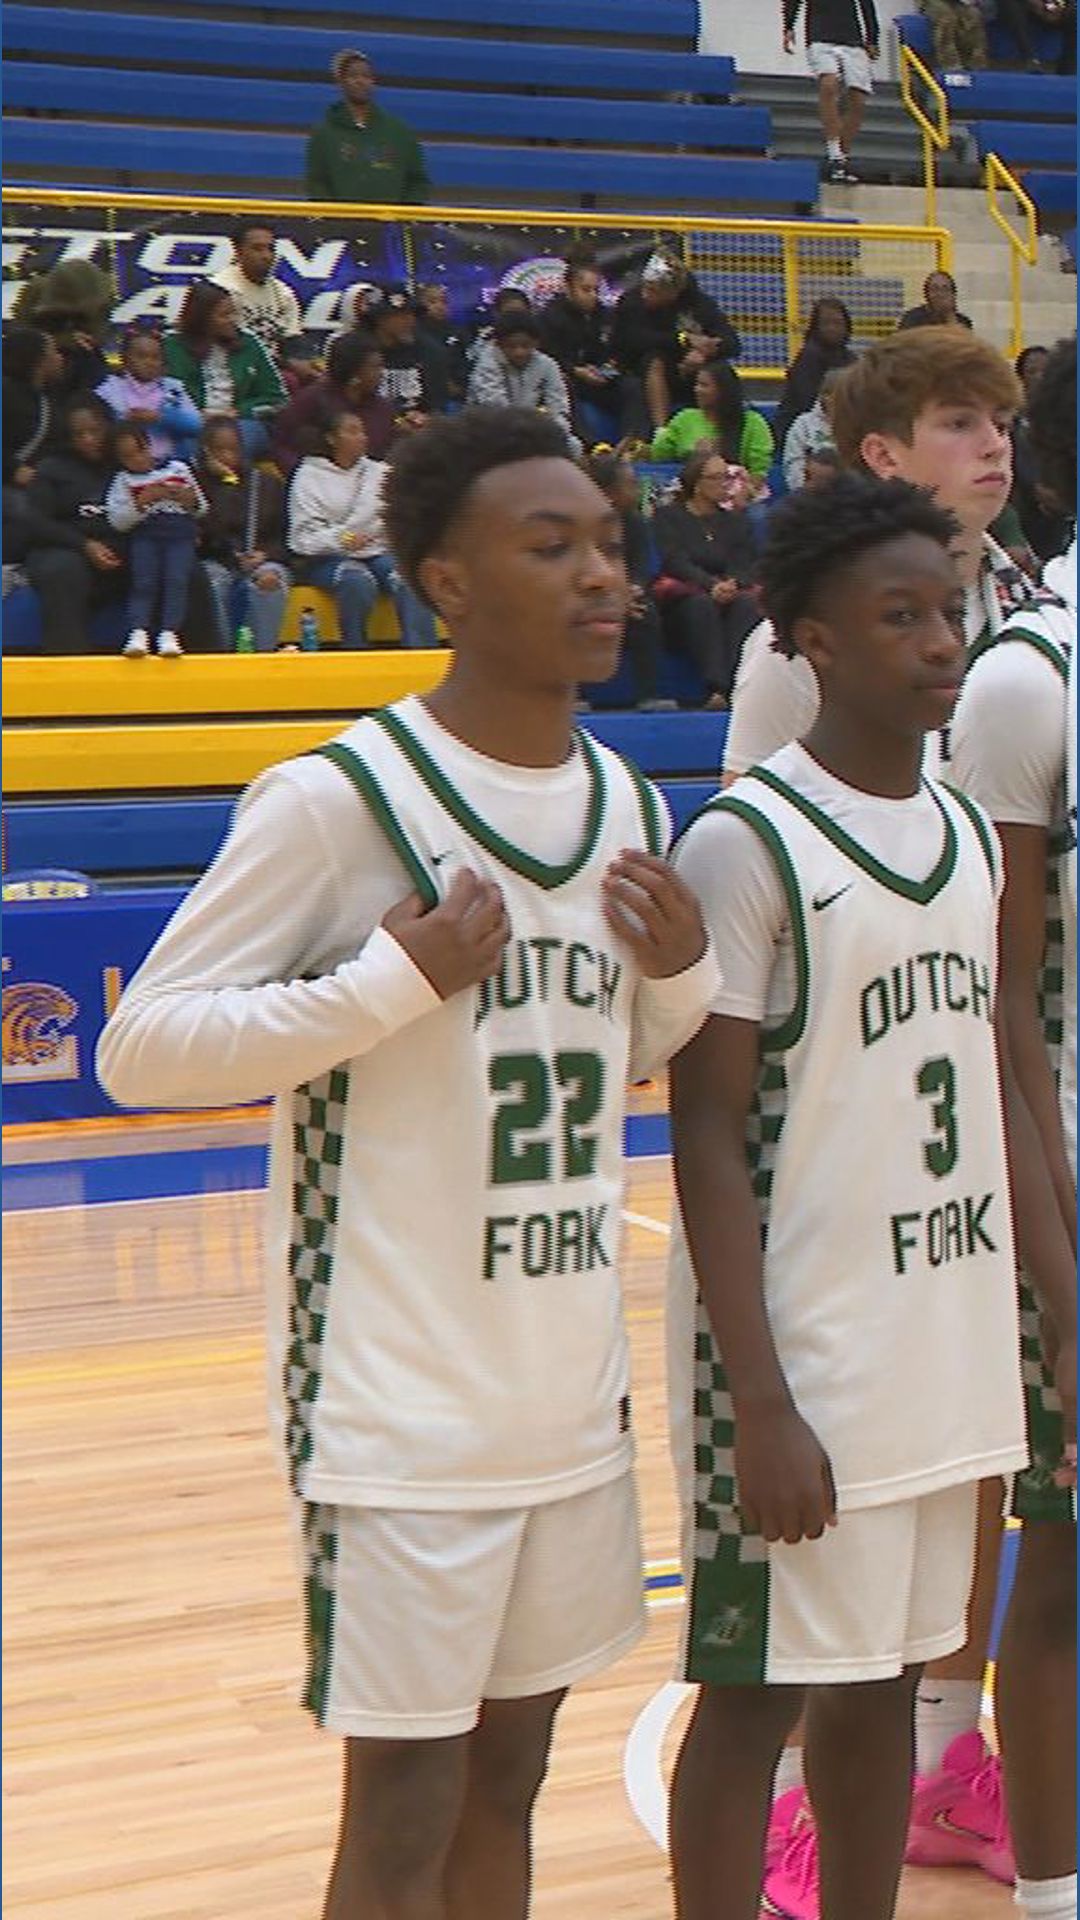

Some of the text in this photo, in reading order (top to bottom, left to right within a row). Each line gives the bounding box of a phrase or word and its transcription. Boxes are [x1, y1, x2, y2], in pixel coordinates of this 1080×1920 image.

[861, 951, 995, 1049] DUTCH
[486, 1050, 608, 1185] 22
[915, 1055, 960, 1181] 3
[481, 1204, 613, 1281] FORK
[890, 1192, 999, 1276] FORK
